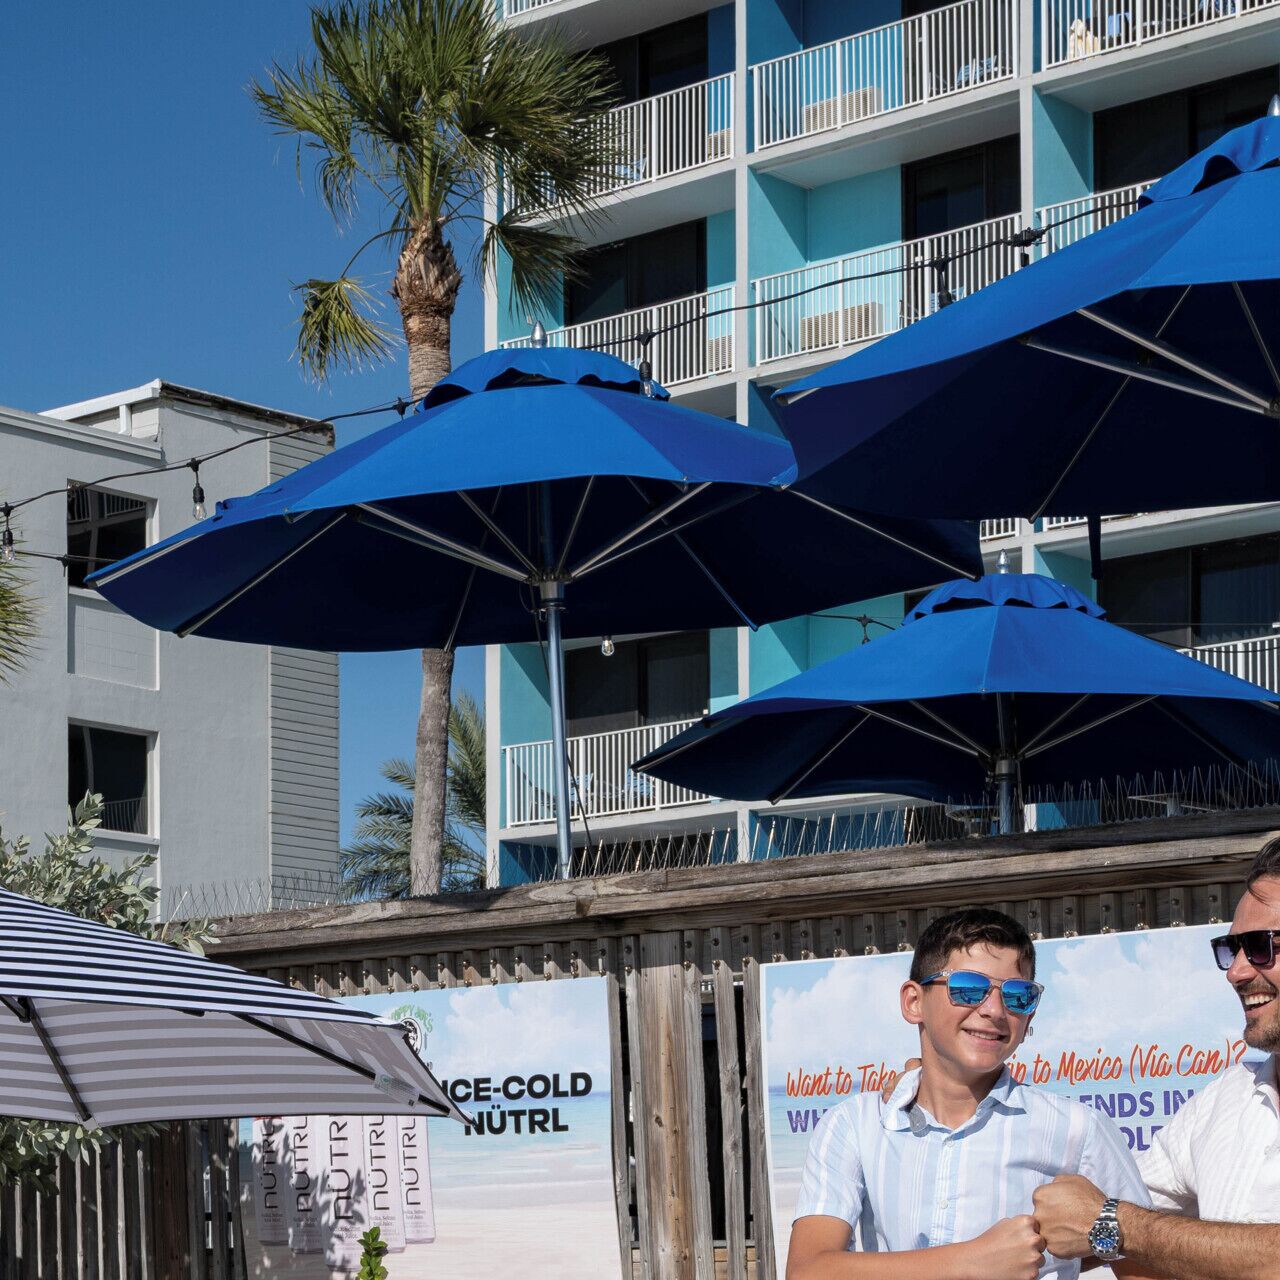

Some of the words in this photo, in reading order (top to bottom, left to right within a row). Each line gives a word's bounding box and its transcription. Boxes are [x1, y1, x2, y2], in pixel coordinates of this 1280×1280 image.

[786, 1065, 833, 1097] Want
[835, 1066, 852, 1095] to
[1033, 1053, 1052, 1084] to
[1056, 1048, 1123, 1086] Mexico
[1129, 1043, 1172, 1084] (Via
[1176, 1038, 1248, 1077] Can)?
[441, 1072, 593, 1103] ICE-COLD
[465, 1104, 569, 1136] NÜTRL
